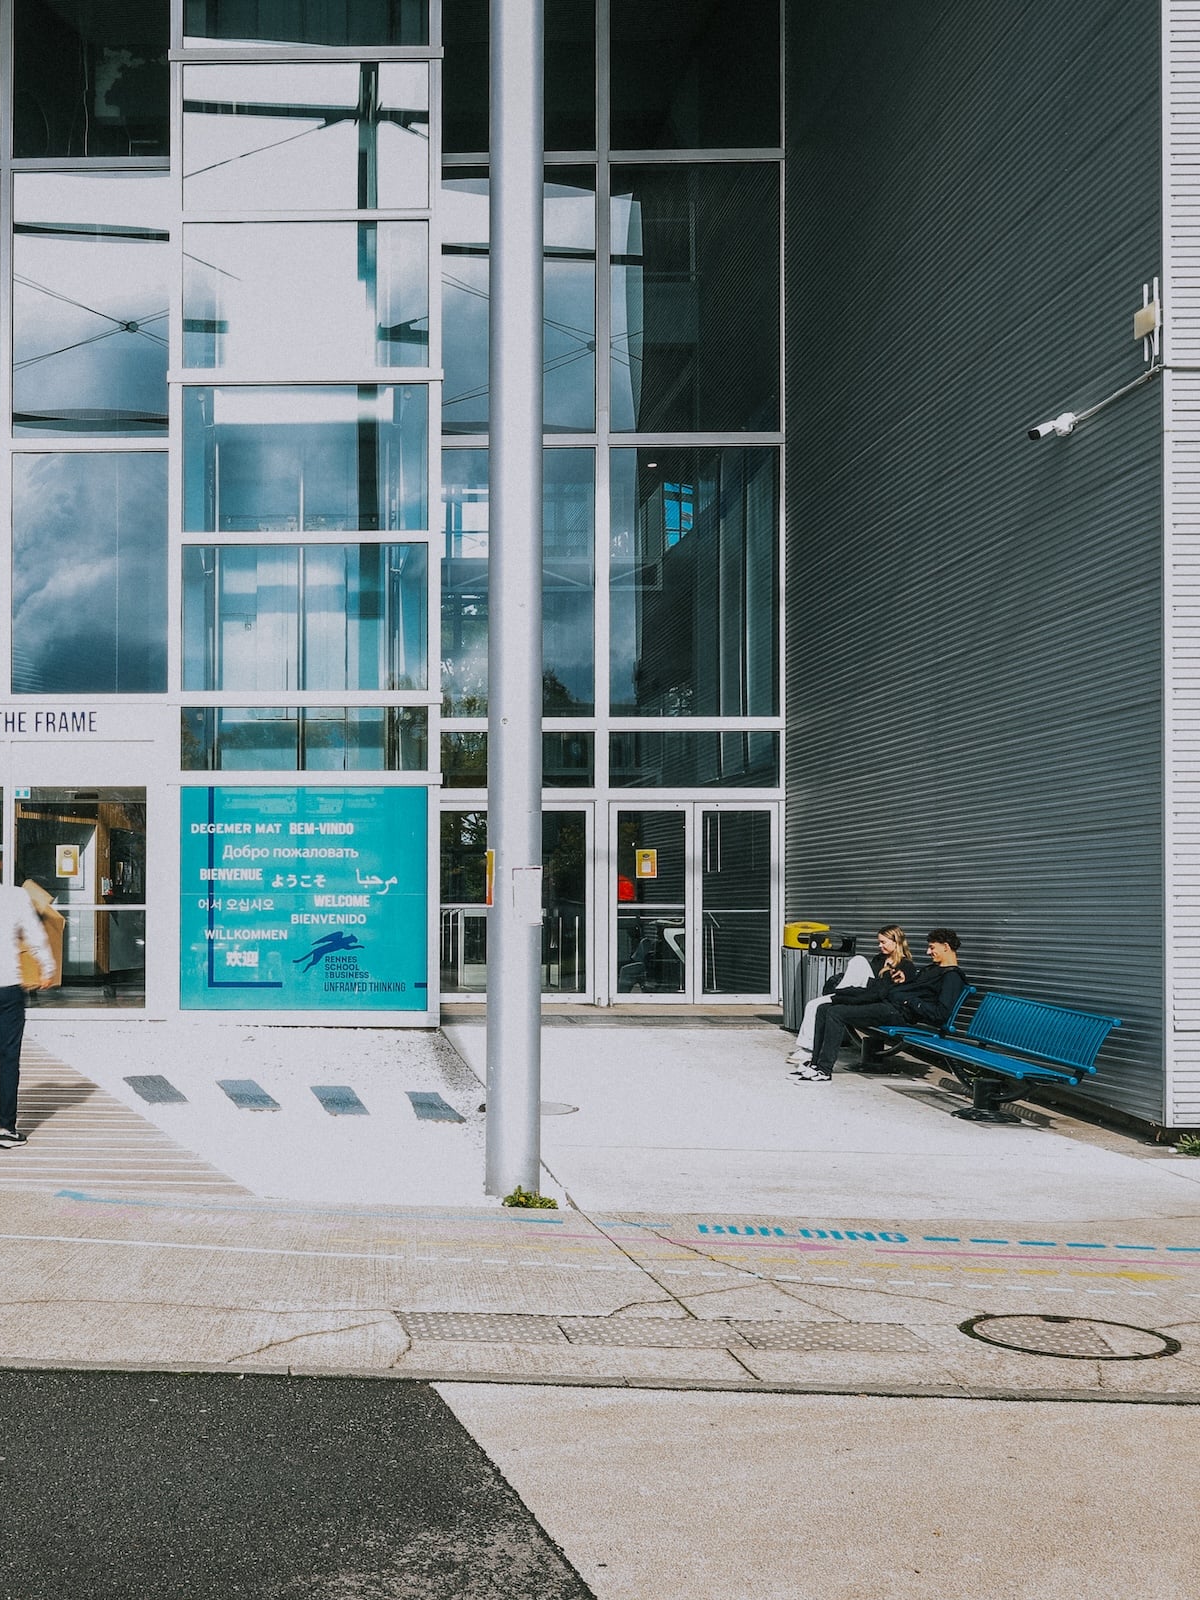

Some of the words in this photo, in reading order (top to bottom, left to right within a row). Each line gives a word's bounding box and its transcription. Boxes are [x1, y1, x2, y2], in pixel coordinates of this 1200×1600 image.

[35, 711, 98, 733] FRAME
[190, 823, 252, 834] DEGEMER
[255, 823, 282, 834] MAT
[289, 822, 355, 835] BEM-VINDO
[222, 844, 270, 861] Добро
[272, 847, 359, 859] пожаловать
[200, 868, 263, 881] BIENVENUE
[271, 874, 327, 888] ようこそ
[355, 868, 398, 894] مرحبا
[198, 898, 222, 912] 어서
[226, 898, 275, 911] 오십시오
[313, 894, 371, 908] WELCOME
[290, 913, 367, 925] BIENVENIDO
[204, 929, 288, 941] WILLKOMMEN
[324, 955, 358, 963] RENNES
[324, 963, 360, 971] SCHOOL
[329, 971, 370, 979] BUSINESS
[324, 981, 368, 992] UNFRAMED
[369, 981, 407, 992] THINKING
[697, 1223, 909, 1244] BUILDING
